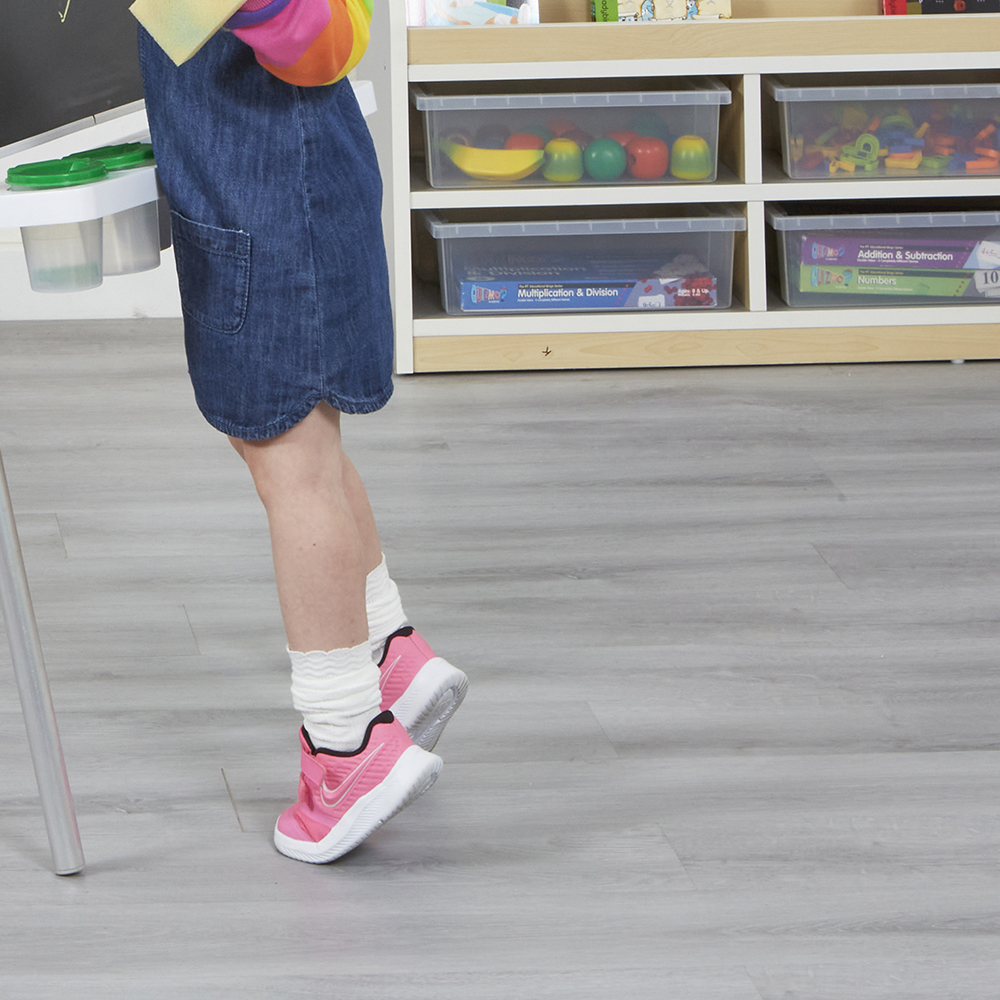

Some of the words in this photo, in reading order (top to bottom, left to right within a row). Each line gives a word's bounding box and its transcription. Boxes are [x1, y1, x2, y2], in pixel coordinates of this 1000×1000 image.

[858, 250, 893, 259] Addition
[895, 250, 903, 259] &
[905, 251, 953, 261] Subtraction
[857, 275, 897, 285] Numbers
[983, 270, 999, 285] 10
[517, 289, 573, 299] Multiplication
[576, 288, 584, 297] &
[586, 288, 619, 297] Division
